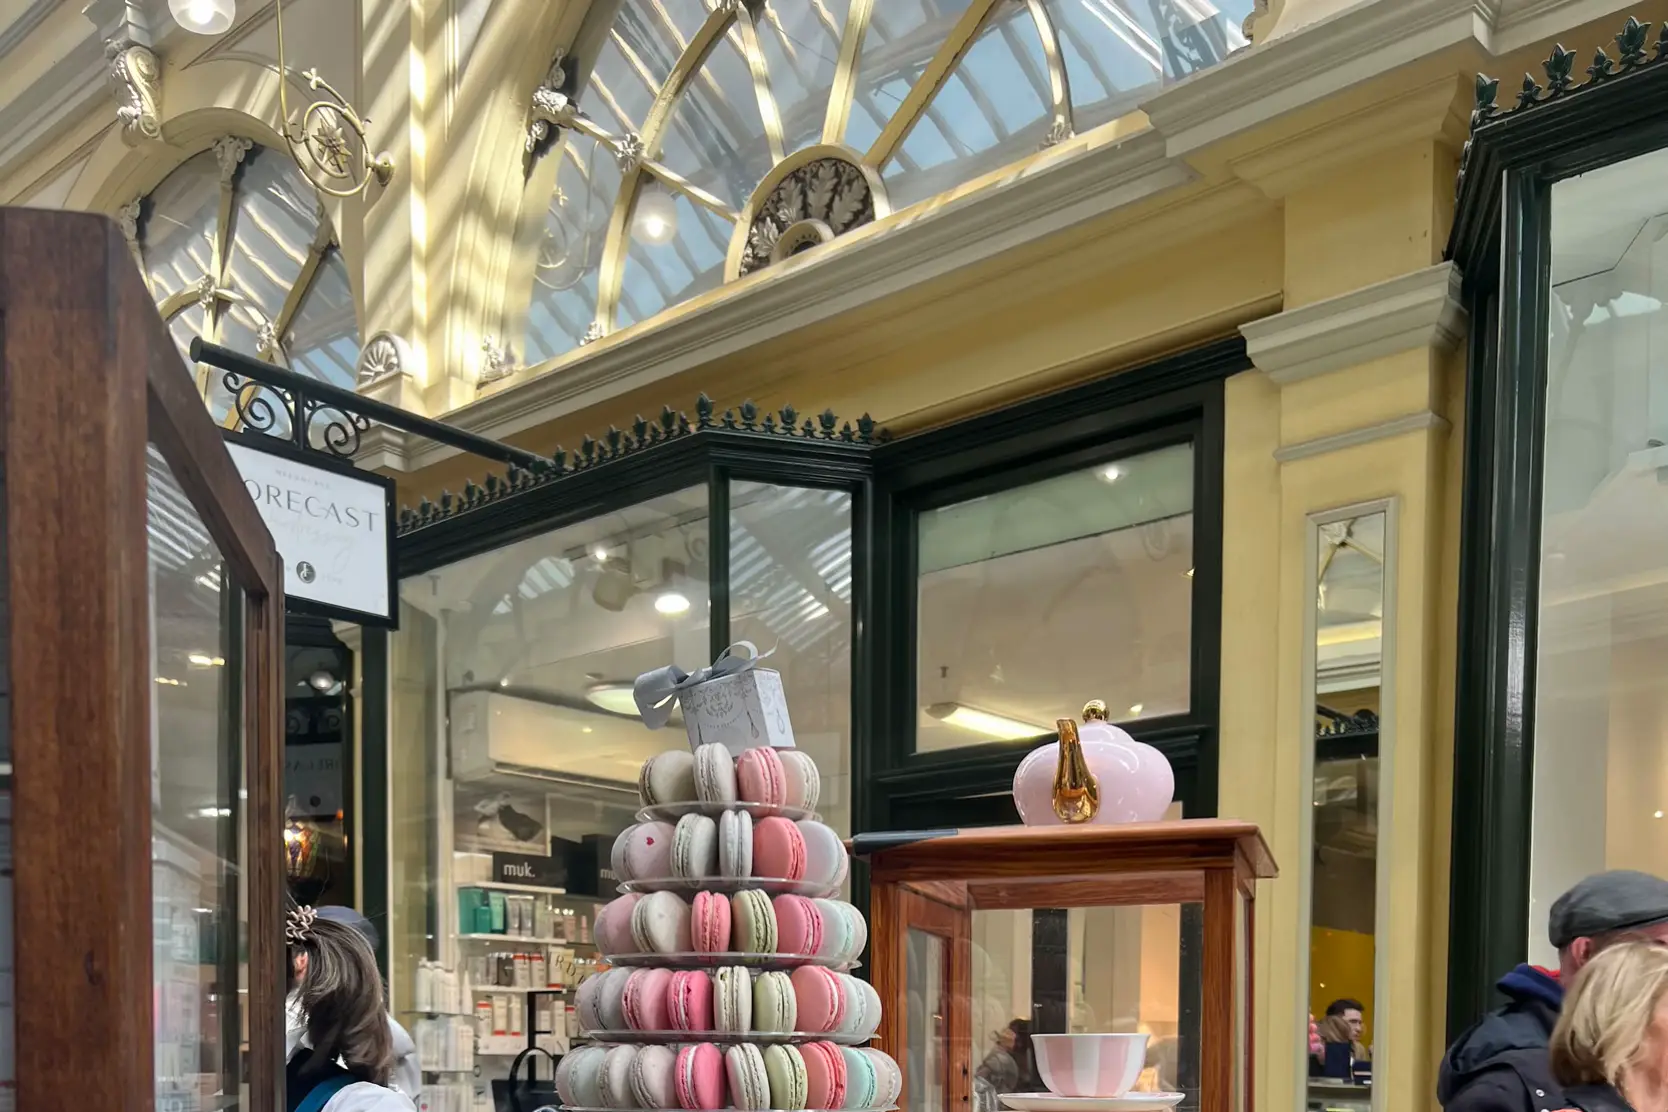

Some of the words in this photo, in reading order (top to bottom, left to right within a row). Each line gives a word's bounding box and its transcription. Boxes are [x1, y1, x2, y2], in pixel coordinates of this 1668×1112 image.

[244, 479, 380, 532] ORECAST
[503, 862, 536, 878] muk.
[600, 868, 618, 880] mu
